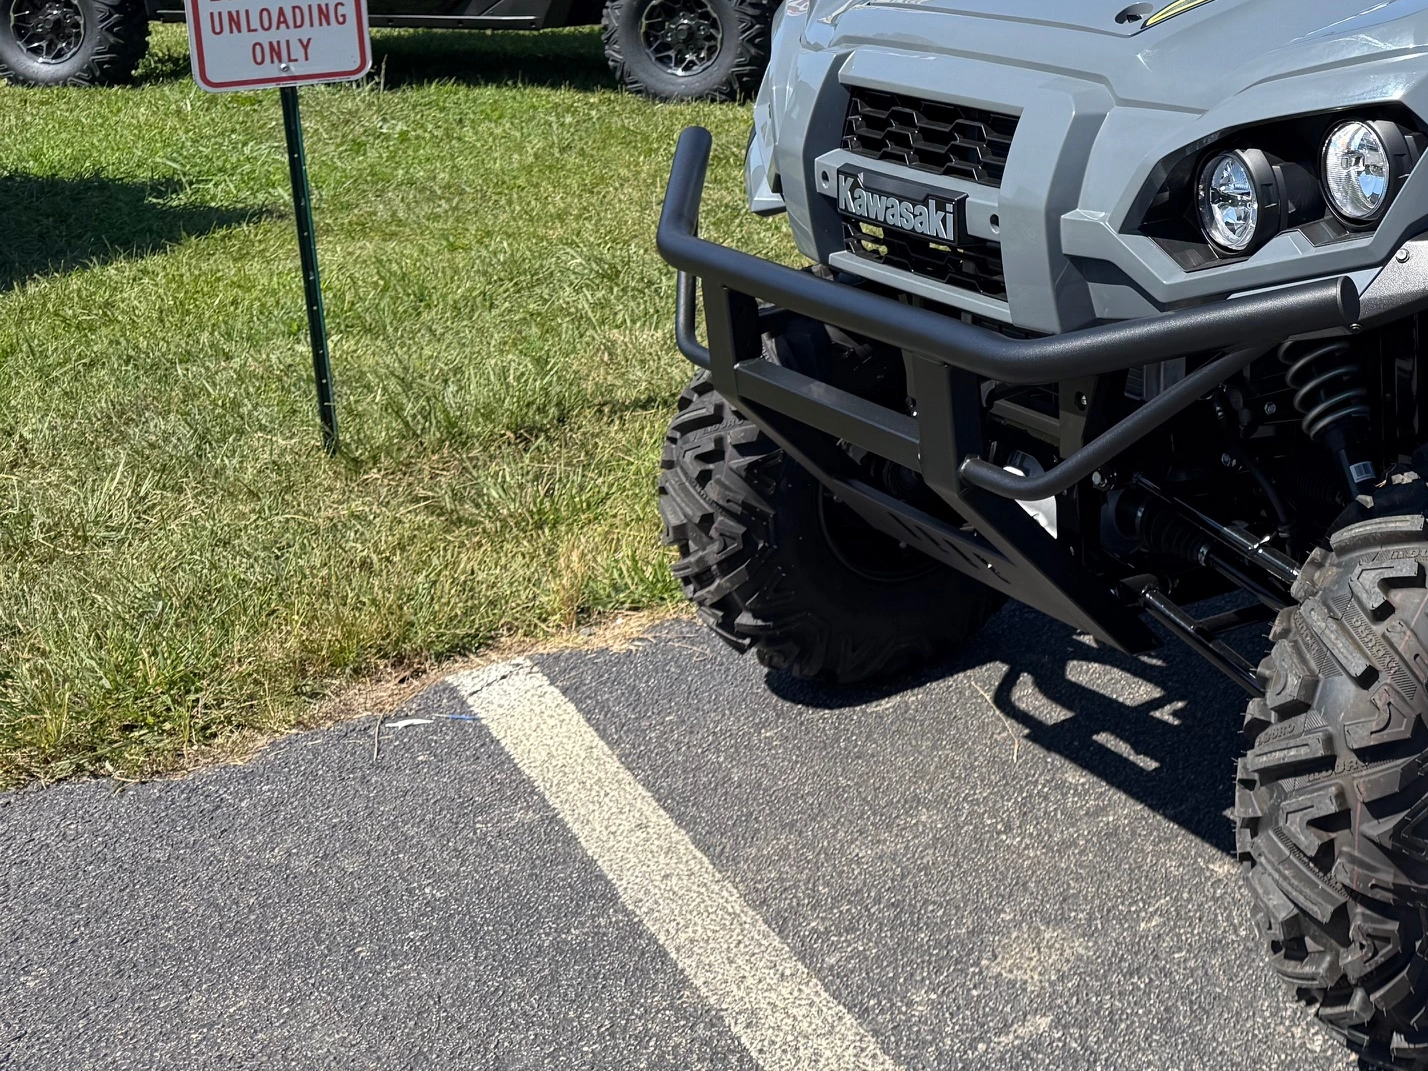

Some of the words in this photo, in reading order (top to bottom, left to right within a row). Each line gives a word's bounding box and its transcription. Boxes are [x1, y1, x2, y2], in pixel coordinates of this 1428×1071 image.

[210, 2, 347, 36] UNLOADING
[252, 38, 313, 66] ONLY
[838, 174, 954, 241] Kawasaki
